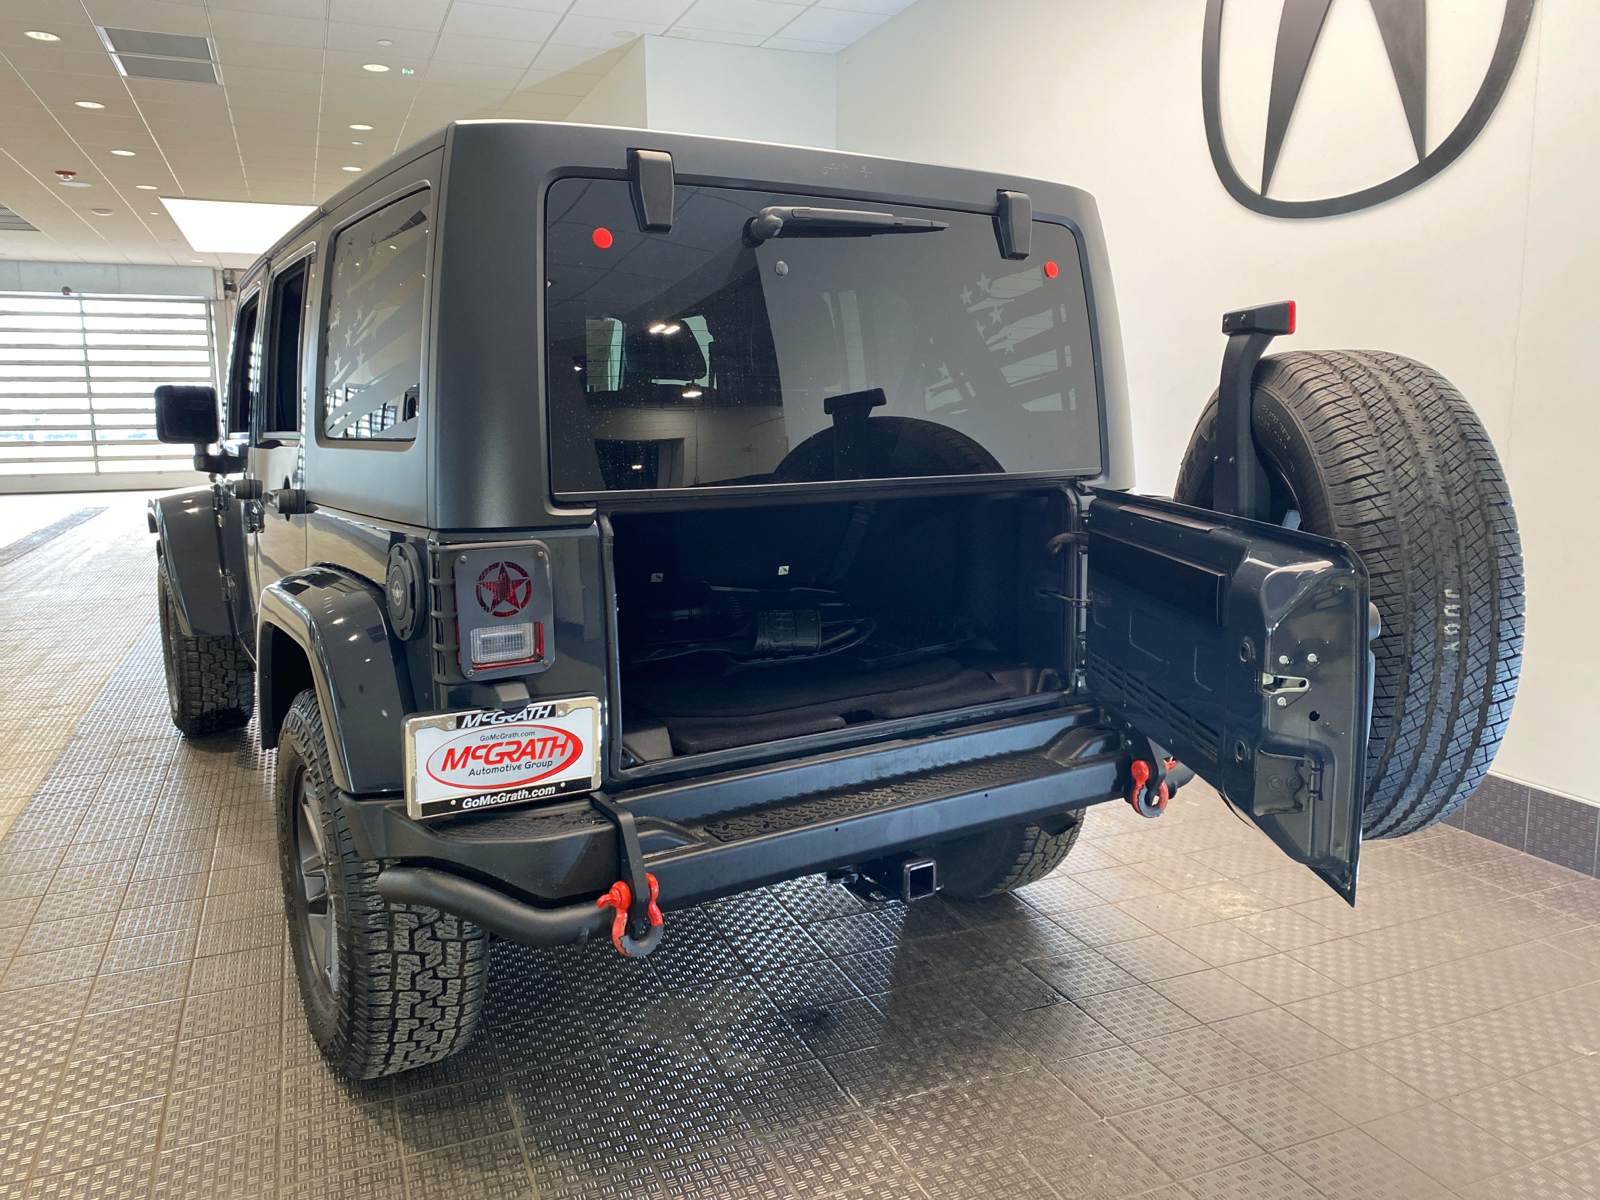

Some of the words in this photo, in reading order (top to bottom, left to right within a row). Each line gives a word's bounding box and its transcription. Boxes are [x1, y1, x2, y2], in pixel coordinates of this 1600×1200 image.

[480, 731, 536, 742] GoMcGrath.com
[441, 736, 570, 771] McGRATH
[468, 764, 522, 776] Automotive
[525, 760, 553, 770] Group
[462, 786, 555, 809] GoMcGrath.com
